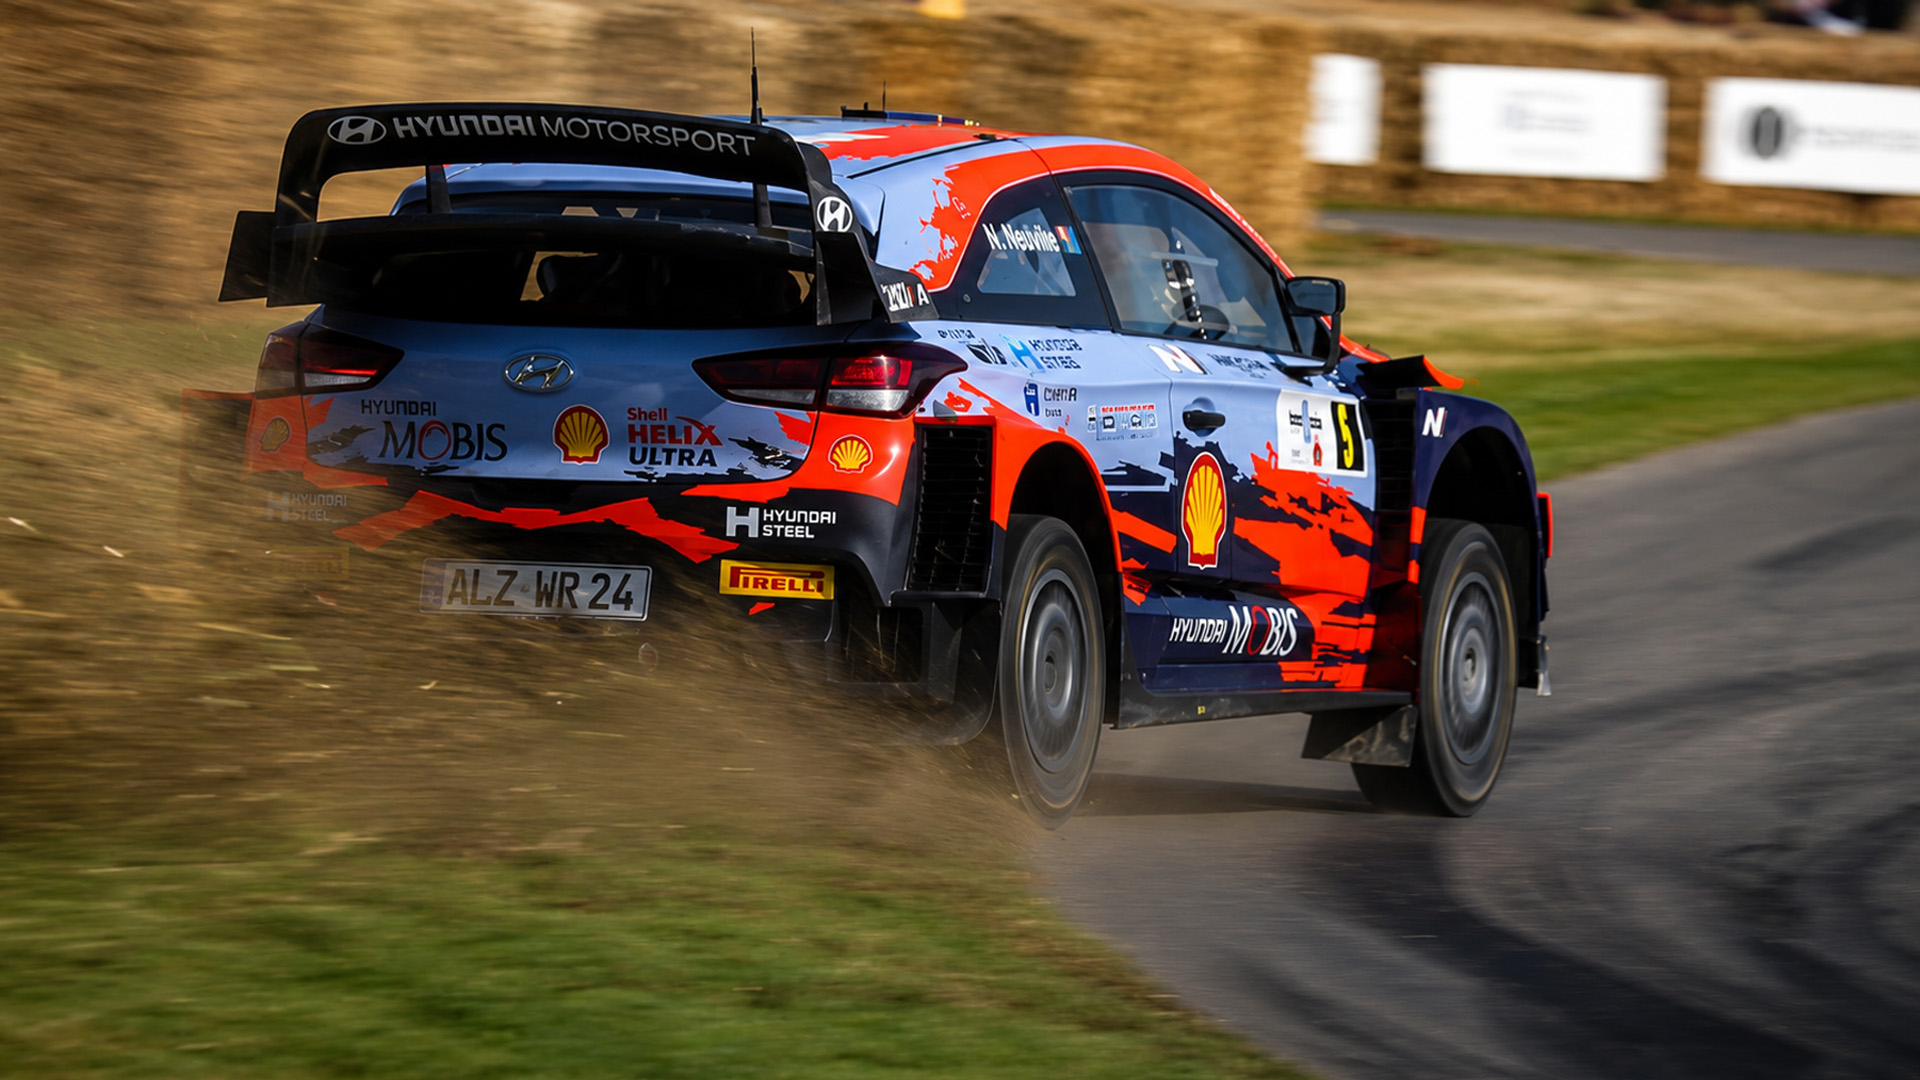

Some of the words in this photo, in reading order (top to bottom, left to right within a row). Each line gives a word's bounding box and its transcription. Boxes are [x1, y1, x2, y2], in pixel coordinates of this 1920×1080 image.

[392, 114, 537, 139] HYUNDAI
[540, 116, 756, 156] MOTORSPORT
[982, 223, 1007, 250] N.
[361, 399, 437, 417] HYUNDAI
[627, 407, 668, 422] Shell
[378, 419, 508, 462] MOBIS
[627, 415, 724, 446] HELIX
[1337, 403, 1354, 469] 5
[629, 446, 718, 468] ULTRA
[763, 509, 837, 524] HYUNDAI
[762, 524, 815, 538] STEEL
[446, 569, 518, 606] ALZ
[535, 570, 580, 609] WR
[588, 573, 634, 611] 24
[729, 566, 826, 593] PIRELLI
[1169, 618, 1228, 643] HYUNDAI
[1222, 605, 1298, 656] MOBIS
